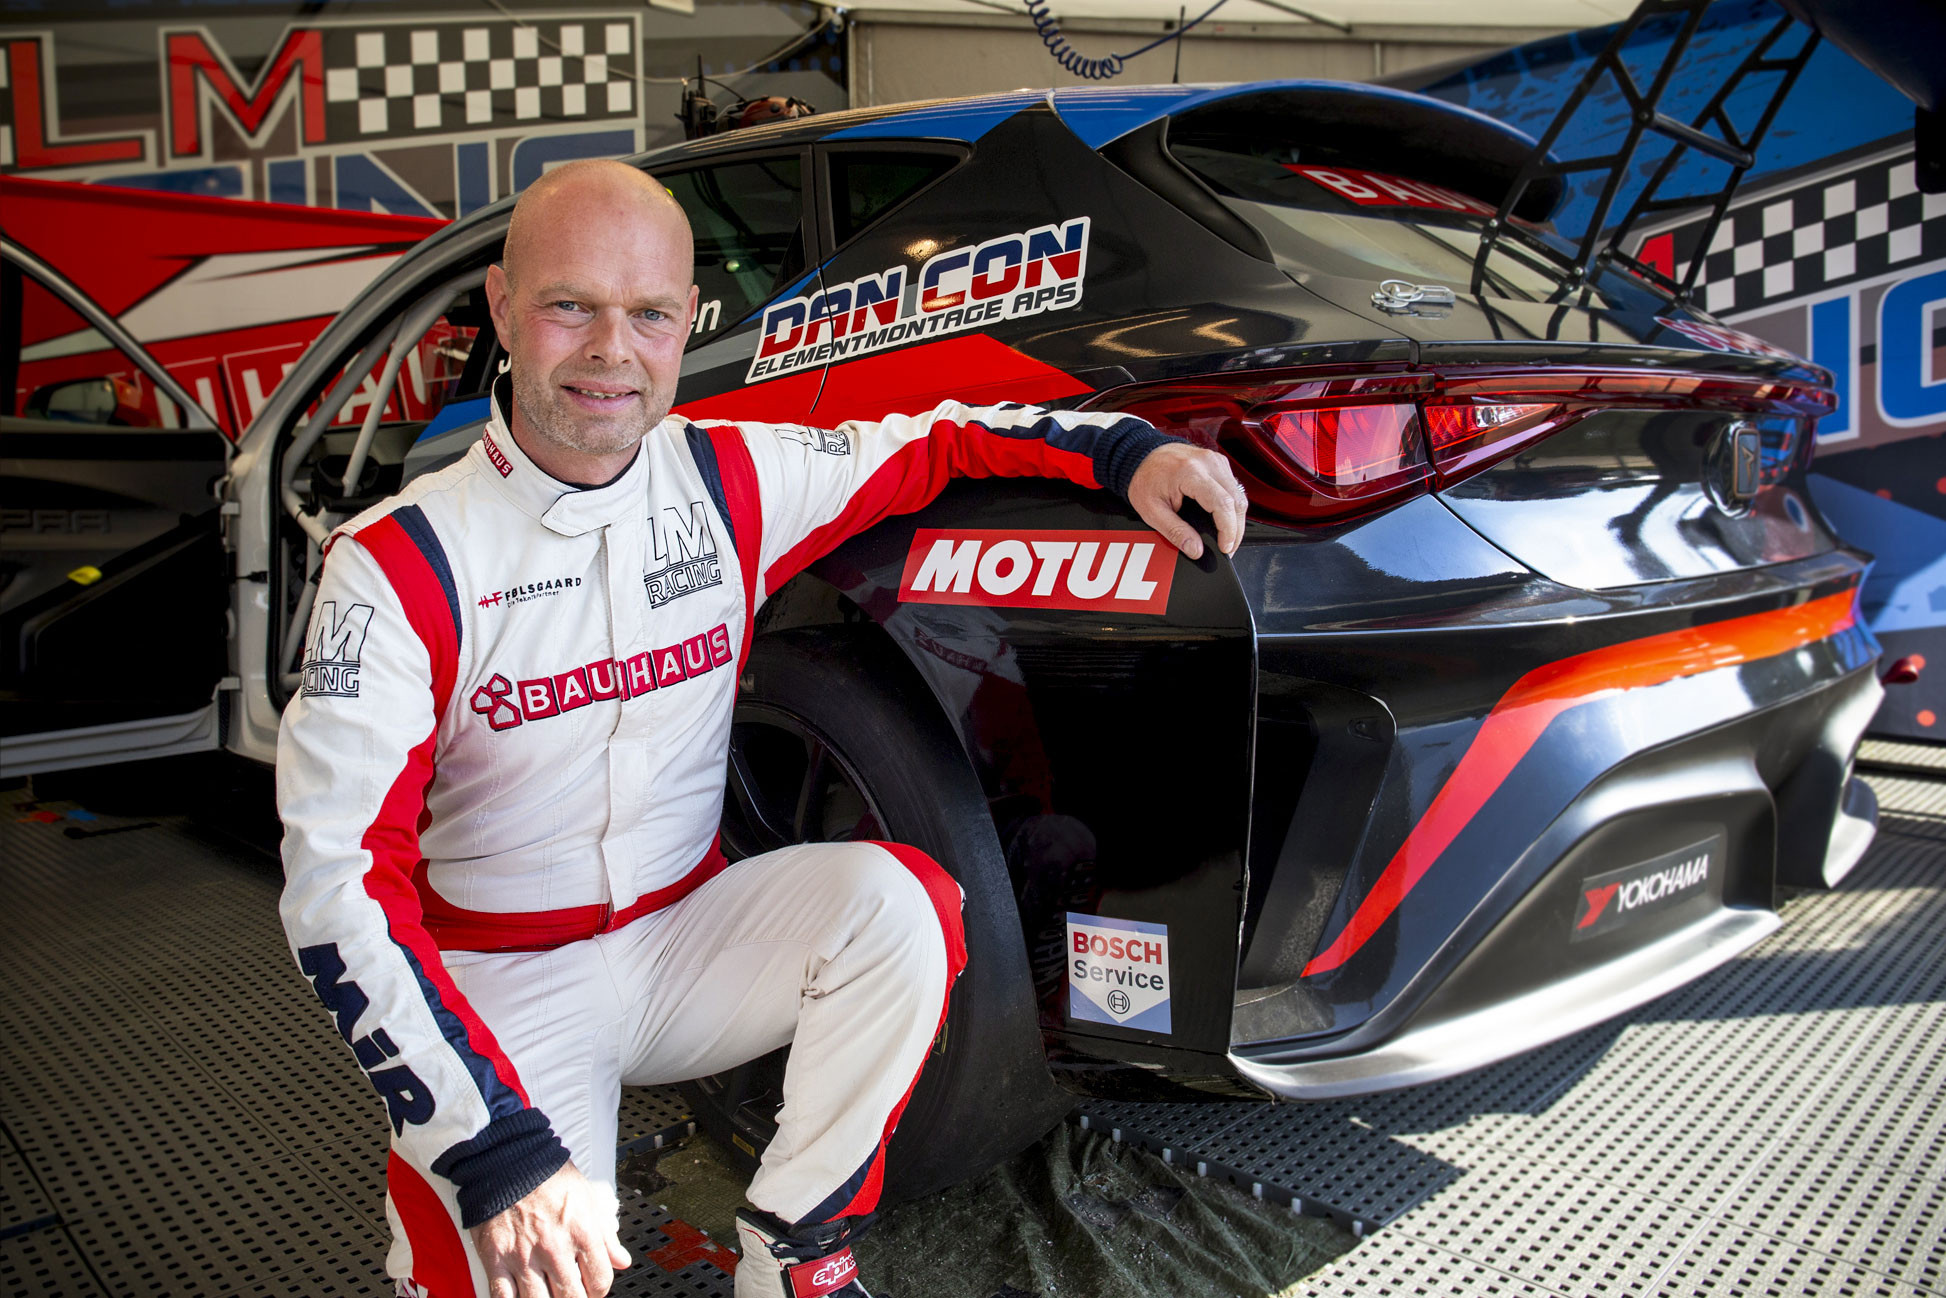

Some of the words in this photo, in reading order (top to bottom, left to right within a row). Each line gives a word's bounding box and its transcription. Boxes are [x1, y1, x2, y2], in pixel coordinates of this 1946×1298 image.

[759, 270, 903, 360] DAN
[920, 222, 1085, 314] CON
[750, 297, 1004, 380] ELEMENTMONTAGE
[961, 281, 1078, 315] APS
[643, 501, 718, 575] LM
[505, 577, 583, 602] FØLSGAARD
[645, 559, 722, 605] RACING
[910, 539, 1159, 601] MOTUL
[523, 627, 730, 714] BAUHAUS
[1616, 853, 1709, 913] YOKOHAMA
[1072, 931, 1163, 966] BOSCH
[1073, 959, 1165, 992] Service
